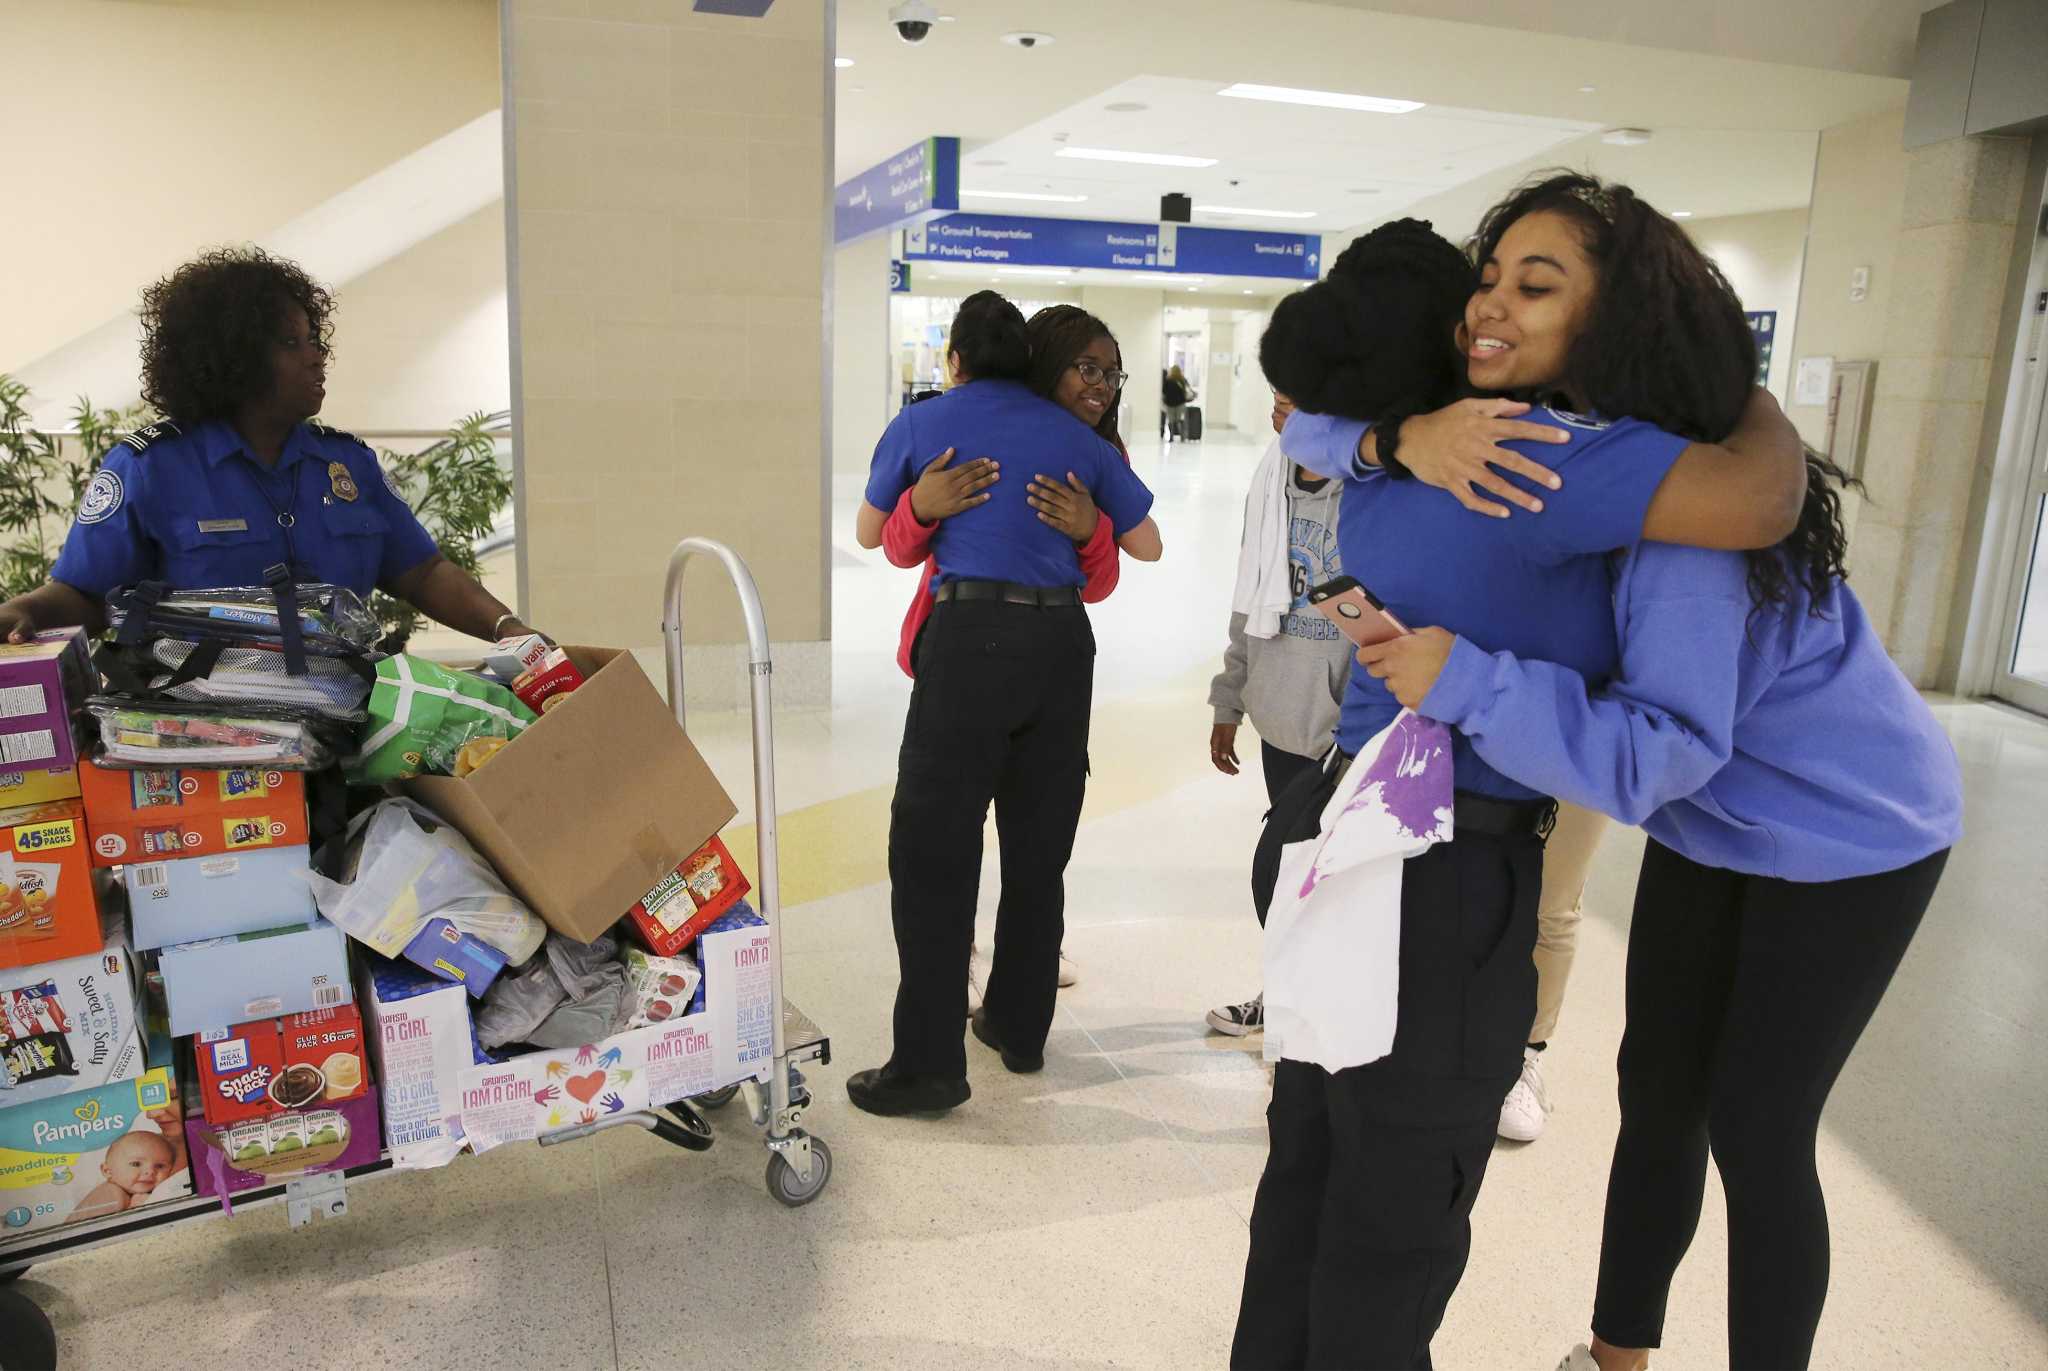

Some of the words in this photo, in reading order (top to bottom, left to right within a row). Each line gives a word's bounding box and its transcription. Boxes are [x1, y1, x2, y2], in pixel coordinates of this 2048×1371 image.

[941, 225, 973, 238] Ground
[975, 227, 1033, 241] Transportation
[1106, 234, 1145, 247] Restrooms
[940, 245, 972, 259] Parking
[973, 247, 1009, 259] Garages
[1254, 243, 1285, 256] Terminal
[1286, 244, 1293, 255] A
[1112, 254, 1143, 266] Elevator
[140, 425, 162, 438] TSA
[42, 826, 71, 838] SNACK
[19, 831, 43, 849] 45
[44, 835, 72, 846] PACKS
[101, 837, 116, 854] 45
[640, 870, 683, 908] BOYARDEE
[649, 892, 671, 913] VARIETY
[741, 948, 759, 966] AM
[762, 946, 769, 963] A
[78, 975, 103, 1016] Sweet
[80, 1011, 90, 1036] MIX
[103, 992, 118, 1043] HOLIDAY
[337, 1033, 356, 1041] CUPS
[385, 1025, 396, 1043] A
[399, 1018, 432, 1041] GIRL.
[296, 1034, 317, 1044] CLUB
[296, 1041, 318, 1049] PACK
[321, 1032, 337, 1044] 36
[88, 1031, 110, 1065] Salty
[653, 1040, 672, 1060] AM
[675, 1039, 683, 1056] A
[737, 1050, 749, 1062] WE
[749, 1048, 761, 1060] SEE
[117, 1045, 136, 1079] LIMITED
[220, 1053, 242, 1062] REAL
[218, 1065, 271, 1098] Snack
[470, 1088, 490, 1108] AM
[494, 1086, 502, 1103] A
[270, 1117, 301, 1129] ORGANIC
[306, 1111, 337, 1122] ORGANIC
[33, 1114, 125, 1145] Pampers
[232, 1125, 265, 1137] ORGANIC
[392, 1123, 407, 1133] see
[396, 1131, 410, 1145] THE
[14, 1210, 21, 1221] 1
[35, 1203, 55, 1215] 96
